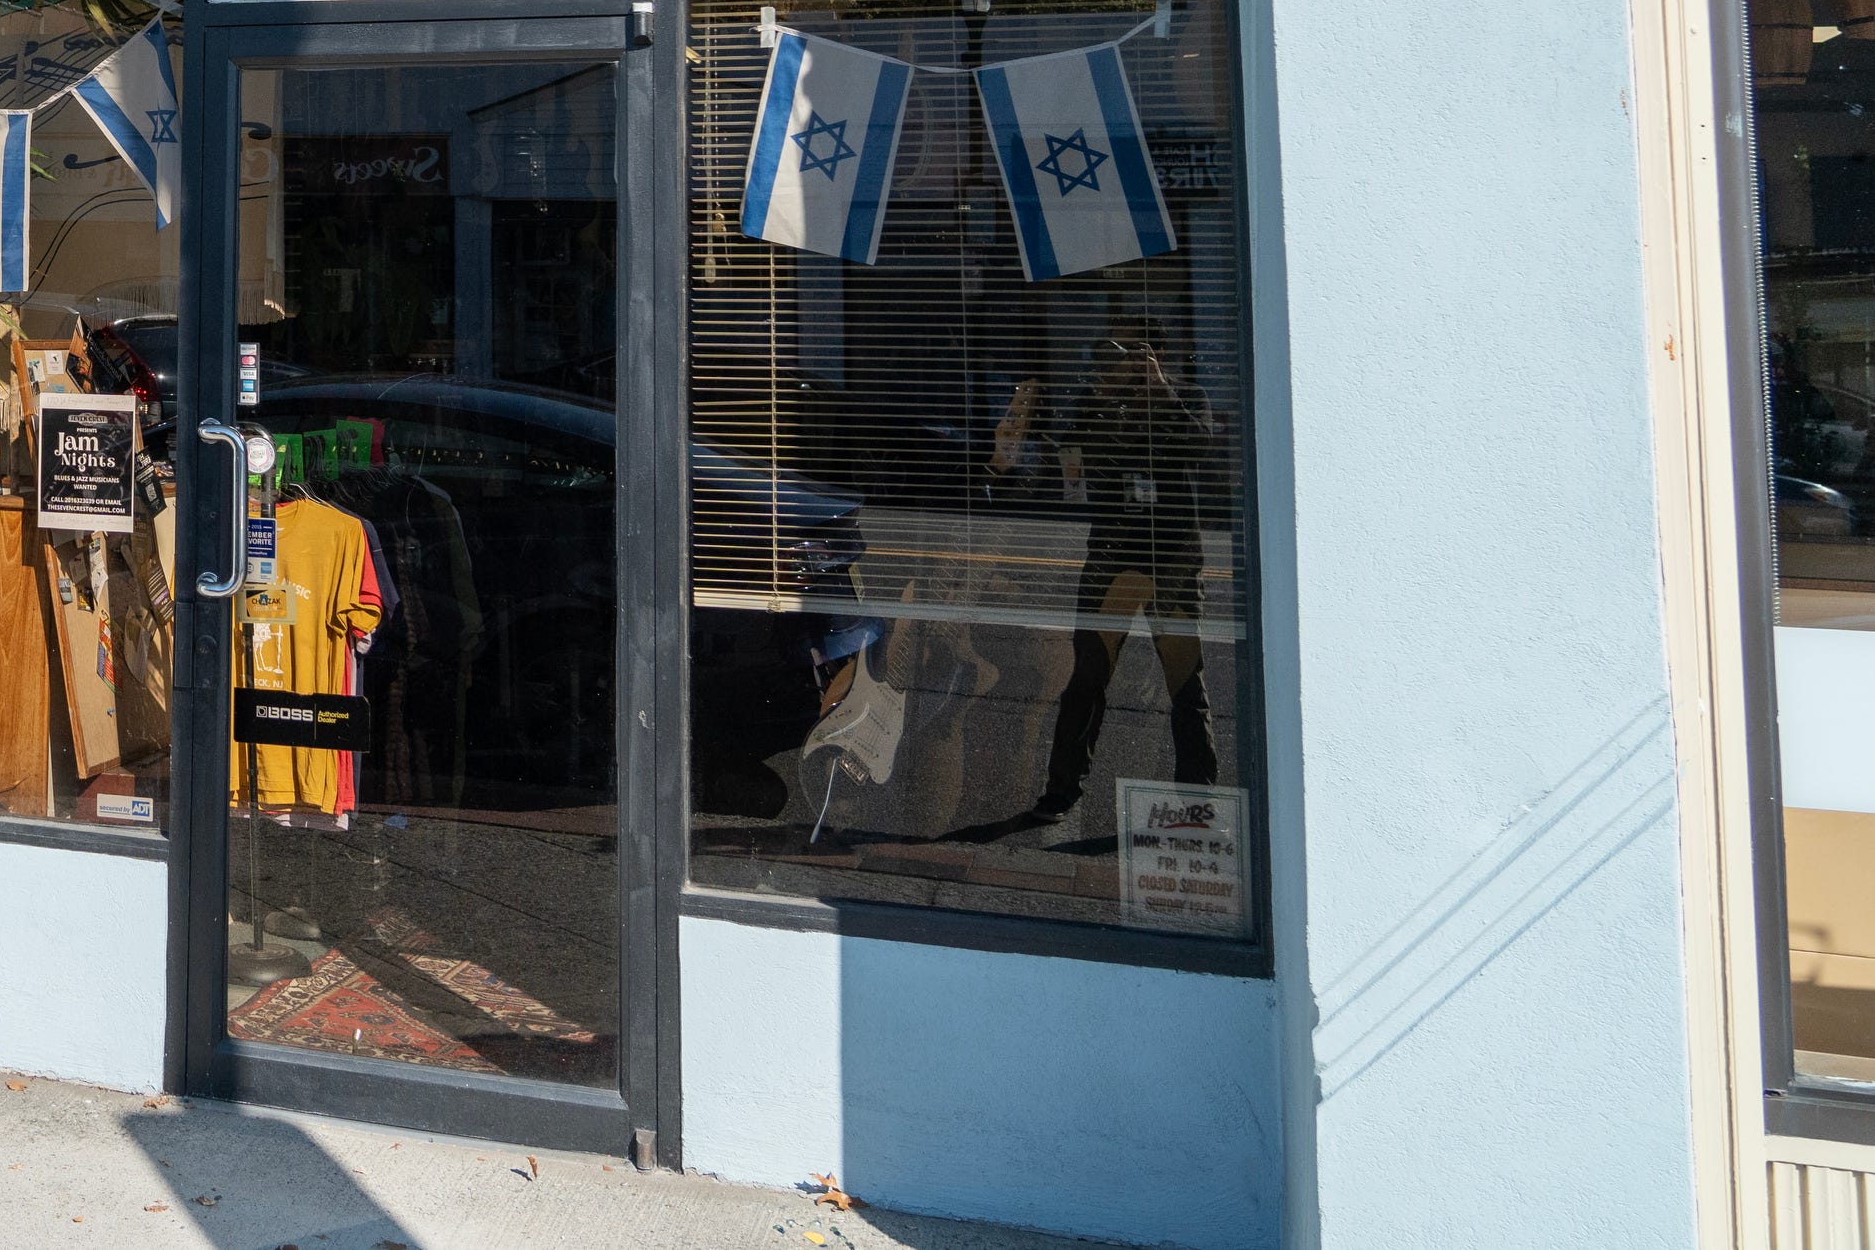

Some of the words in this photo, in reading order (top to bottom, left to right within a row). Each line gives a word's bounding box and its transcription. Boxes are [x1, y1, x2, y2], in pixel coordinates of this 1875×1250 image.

[54, 432, 99, 456] Jam
[61, 452, 116, 472] Nights
[54, 474, 71, 482] BLUES
[76, 475, 88, 483] JAZZ
[89, 476, 120, 484] MUSICIANS
[105, 498, 122, 506] EMAIL
[268, 706, 314, 722] BOSS
[318, 710, 350, 719] Authorized
[318, 716, 337, 724] Dealer
[132, 802, 149, 816] ADT
